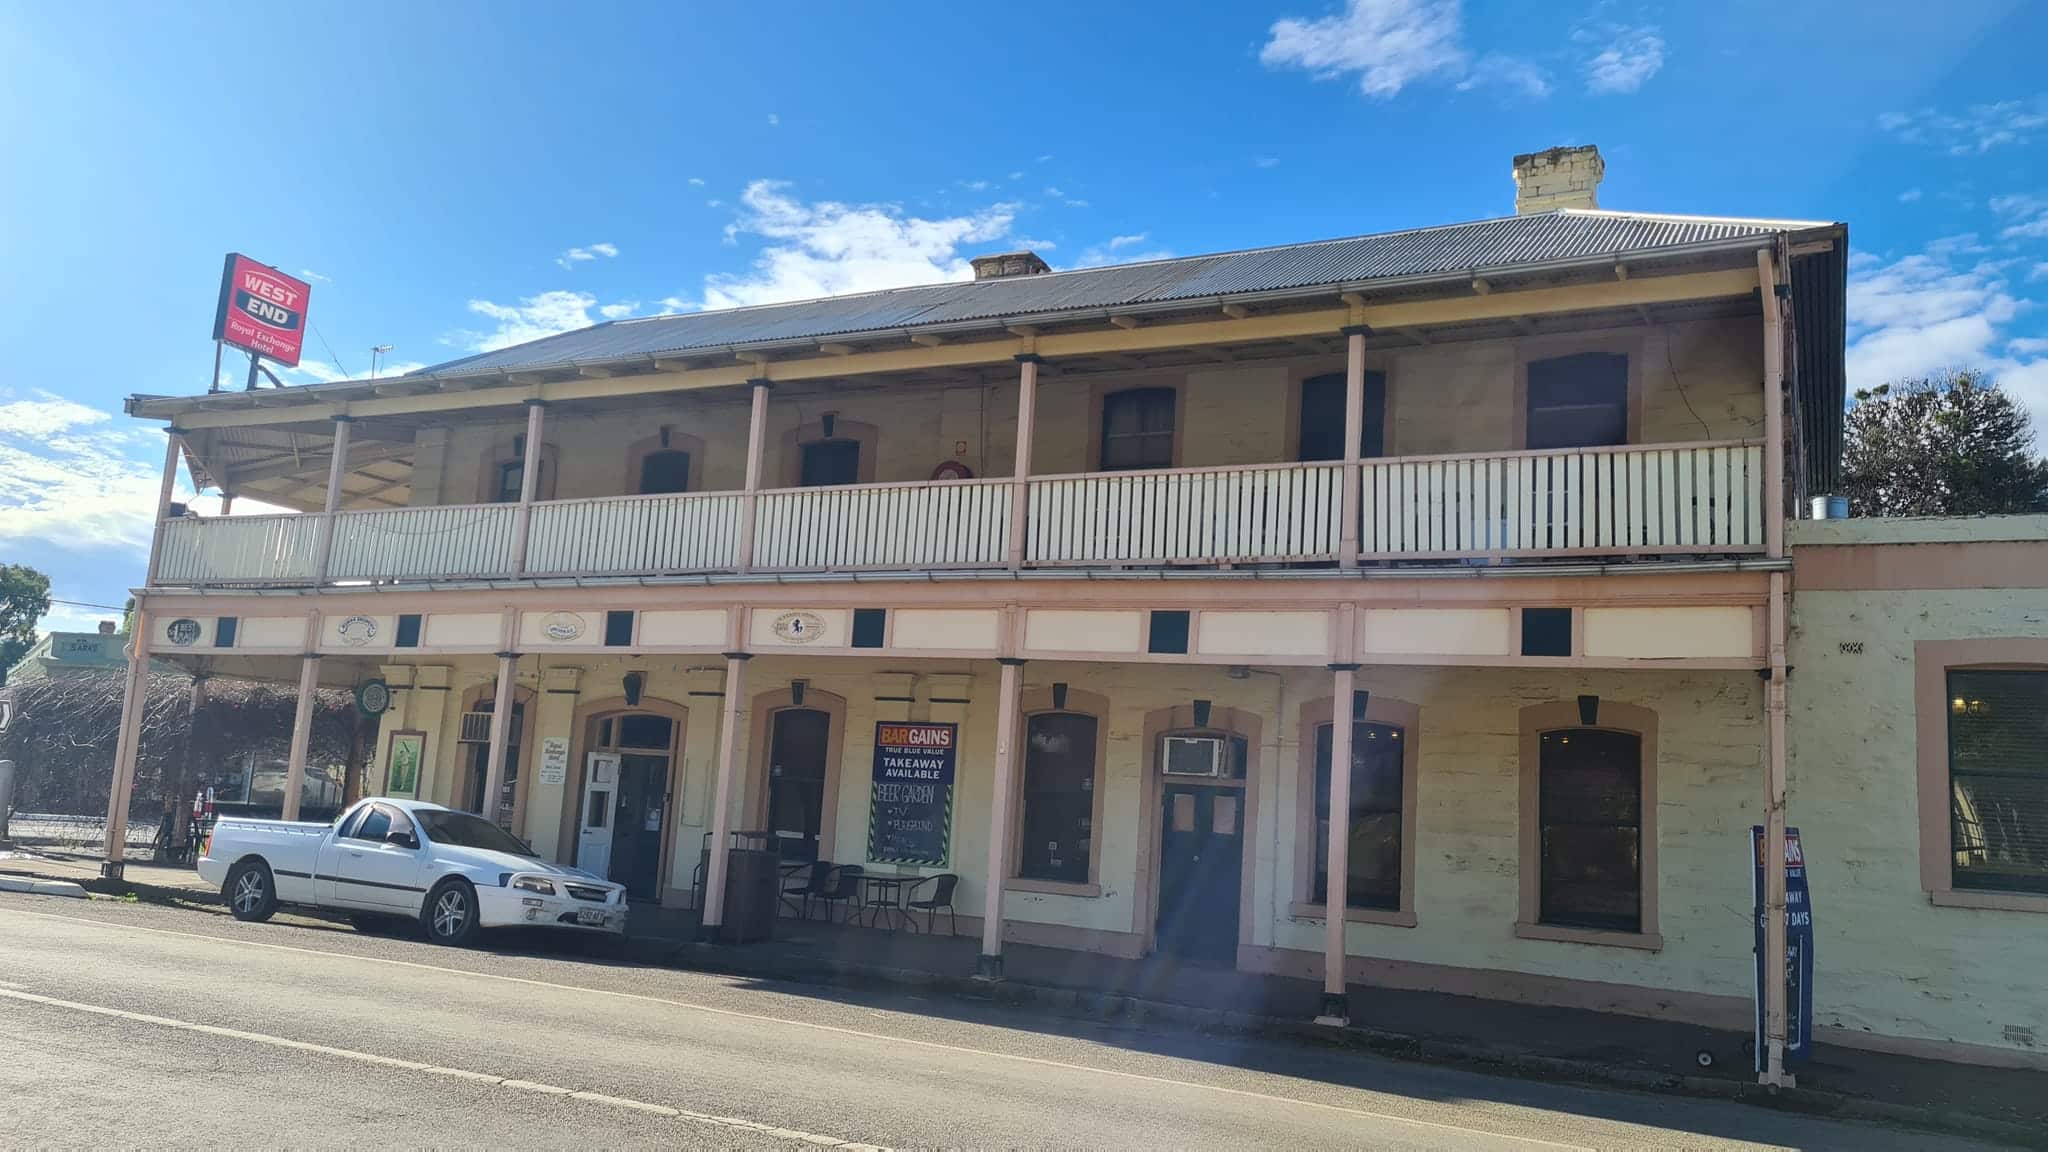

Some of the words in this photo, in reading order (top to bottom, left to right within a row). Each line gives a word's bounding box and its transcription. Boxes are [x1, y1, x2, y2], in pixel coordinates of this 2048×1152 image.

[244, 273, 298, 306] WEST
[246, 297, 289, 324] END
[230, 320, 255, 337] Royal
[250, 339, 275, 354] Hotel
[882, 728, 949, 745] BARGAINS
[885, 746, 902, 754] TRUE
[883, 757, 945, 769] TAKEAWAY
[885, 768, 941, 779] AVAILABLE
[878, 783, 901, 802] BEER
[901, 784, 935, 804] GARDEN
[1791, 911, 1810, 926] DAYS
